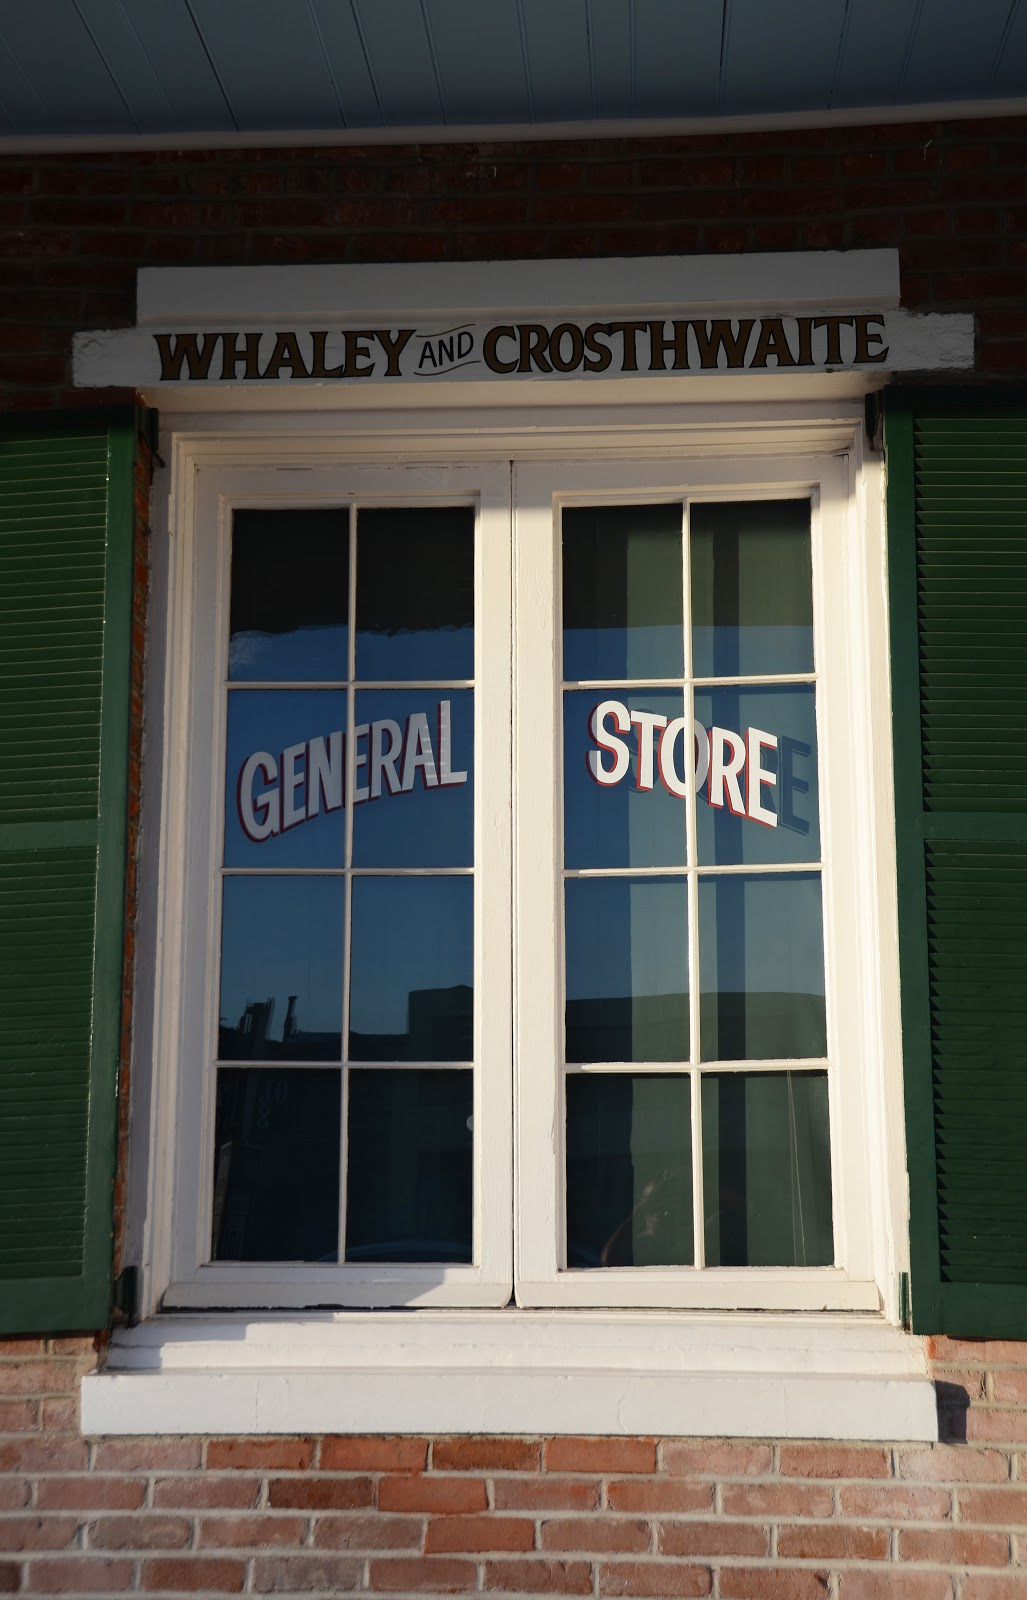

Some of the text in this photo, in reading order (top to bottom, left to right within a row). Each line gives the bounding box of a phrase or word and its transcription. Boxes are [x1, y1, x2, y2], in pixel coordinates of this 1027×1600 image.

[153, 314, 890, 381] WHALEY AND CROSTHWAITE
[236, 700, 778, 843] GENERAL STORE
